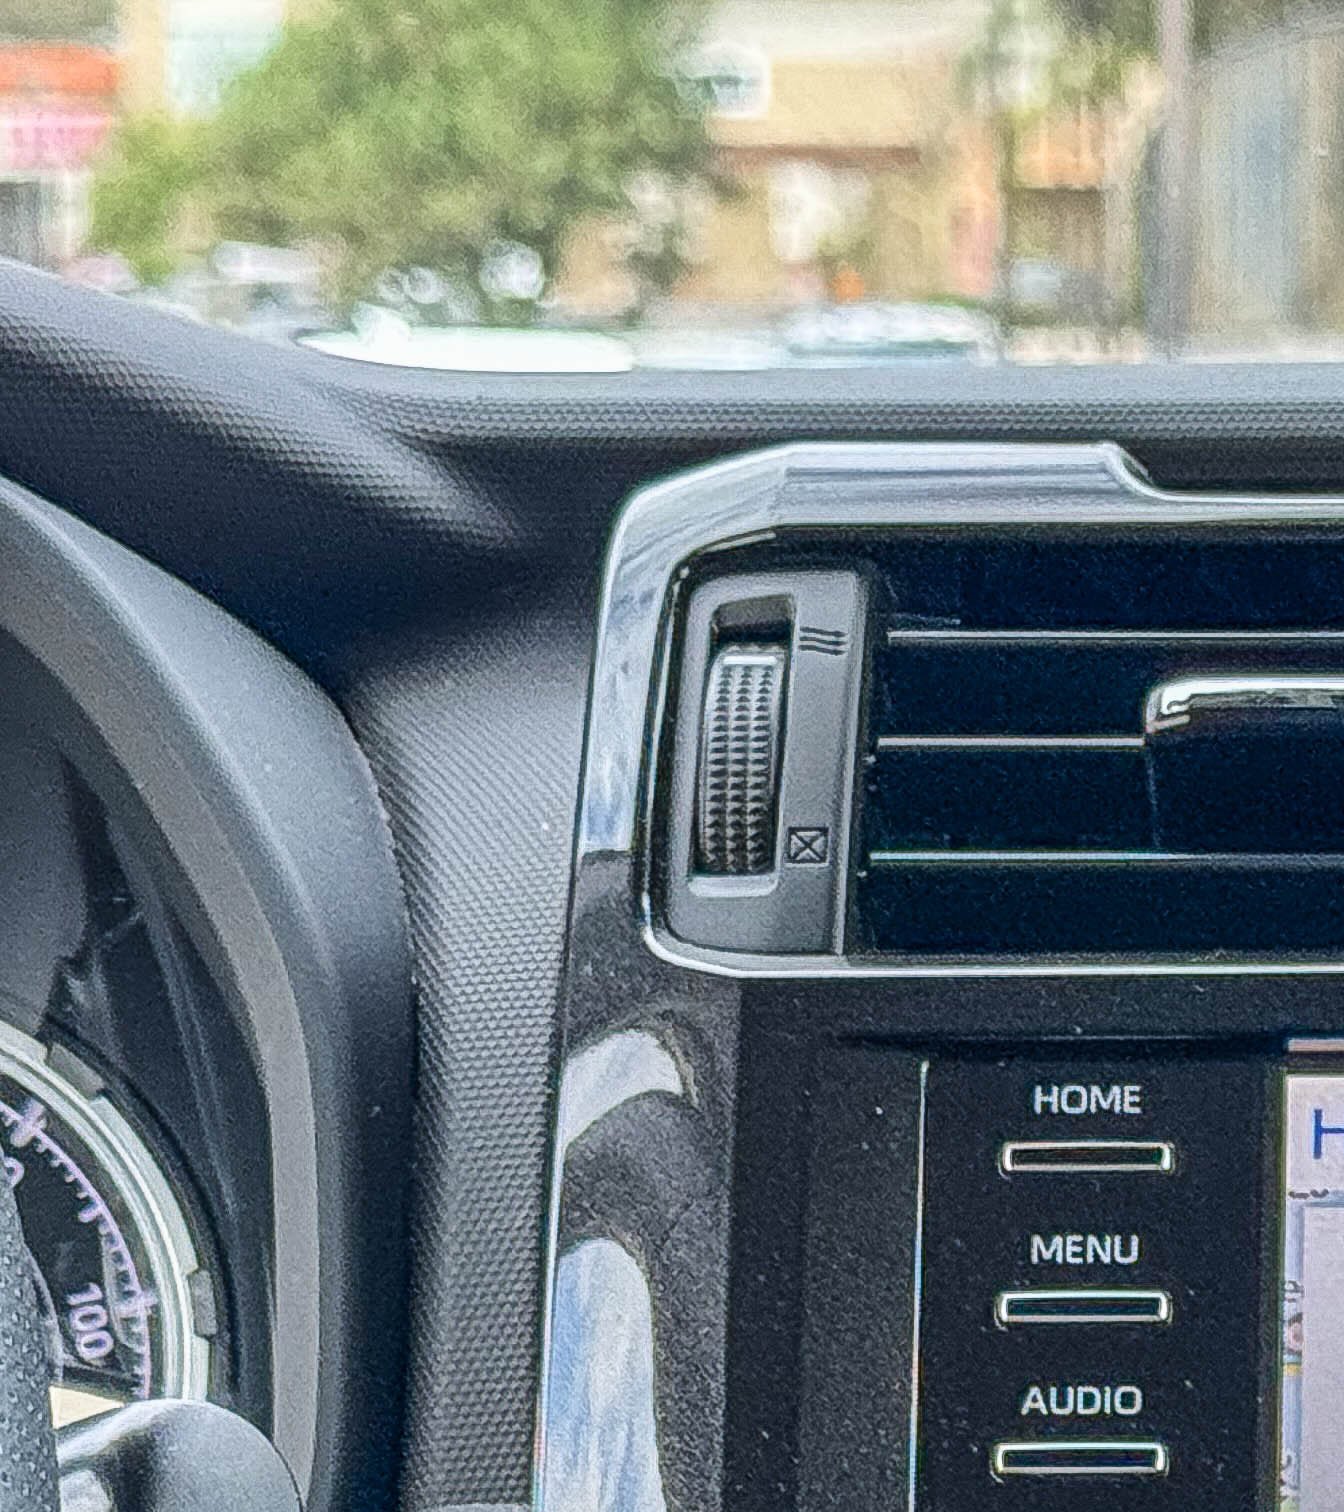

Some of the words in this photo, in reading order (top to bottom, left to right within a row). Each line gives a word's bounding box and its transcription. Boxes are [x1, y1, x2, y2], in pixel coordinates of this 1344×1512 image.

[1032, 1084, 1143, 1114] HOME
[1029, 1234, 1140, 1265] MENU
[1020, 1385, 1143, 1416] AUDIO
